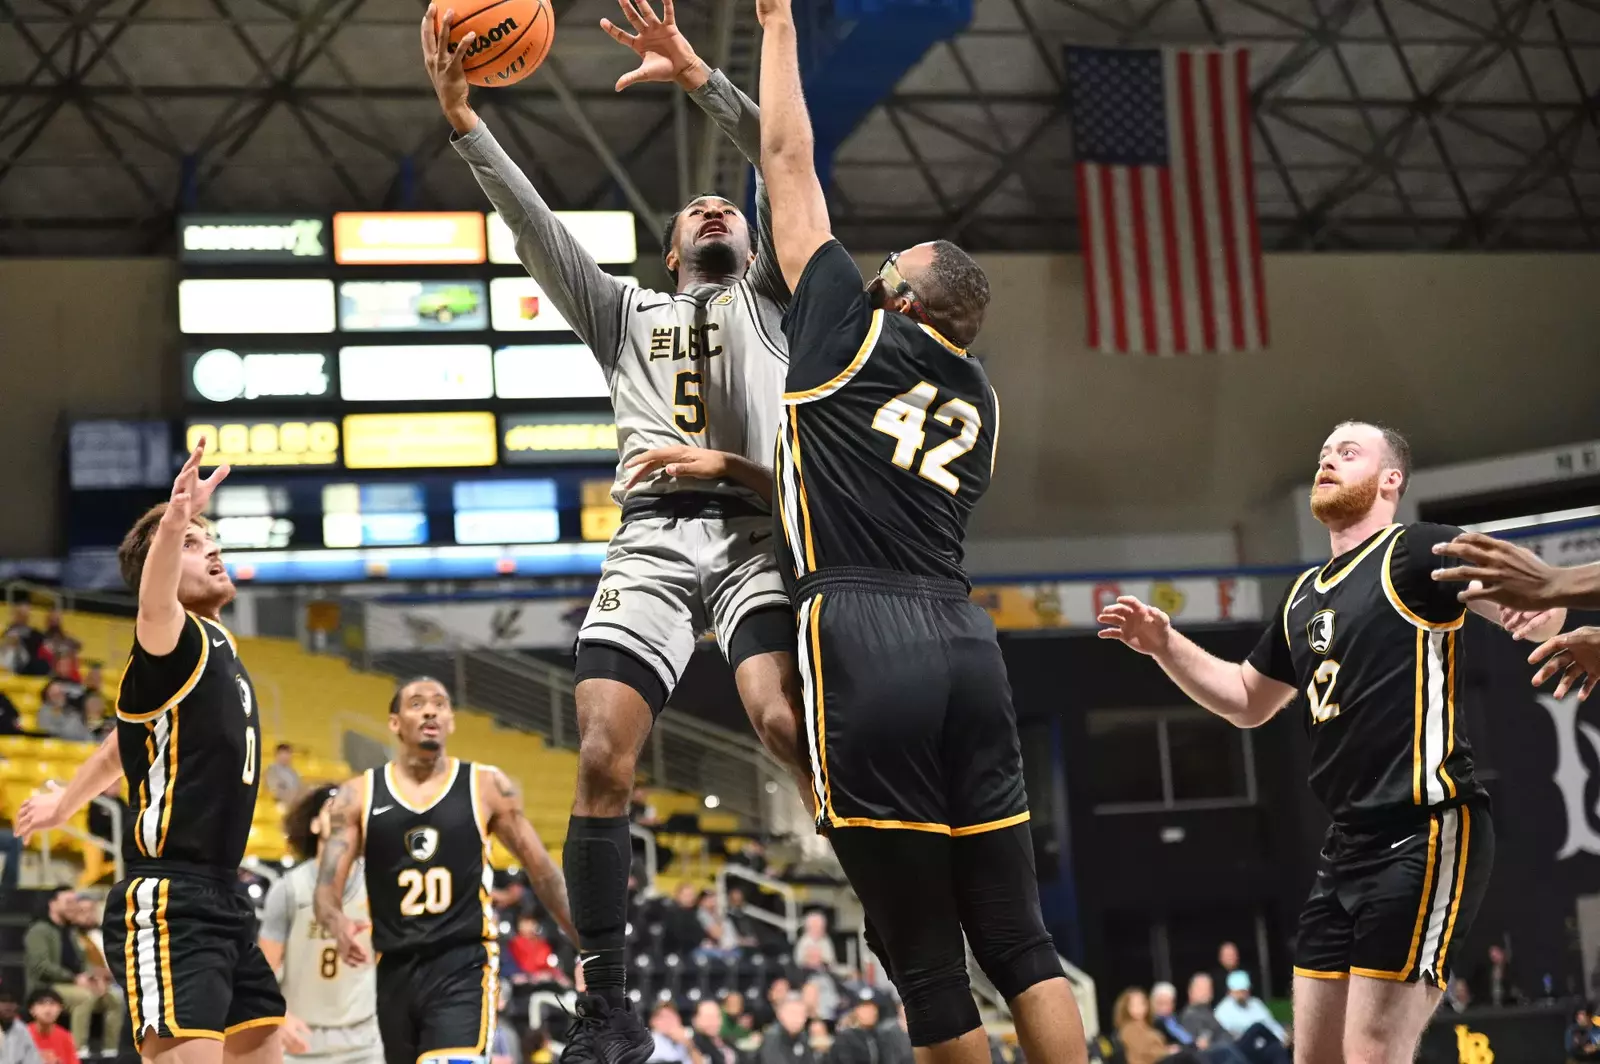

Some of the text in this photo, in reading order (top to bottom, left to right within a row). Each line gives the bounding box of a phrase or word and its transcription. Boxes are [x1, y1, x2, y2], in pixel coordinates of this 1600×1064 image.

[649, 322, 723, 362] THE LBC
[673, 369, 708, 434] 5
[871, 380, 982, 496] 42
[242, 725, 255, 786] 0
[397, 866, 452, 916] 20
[320, 947, 338, 980] 8
